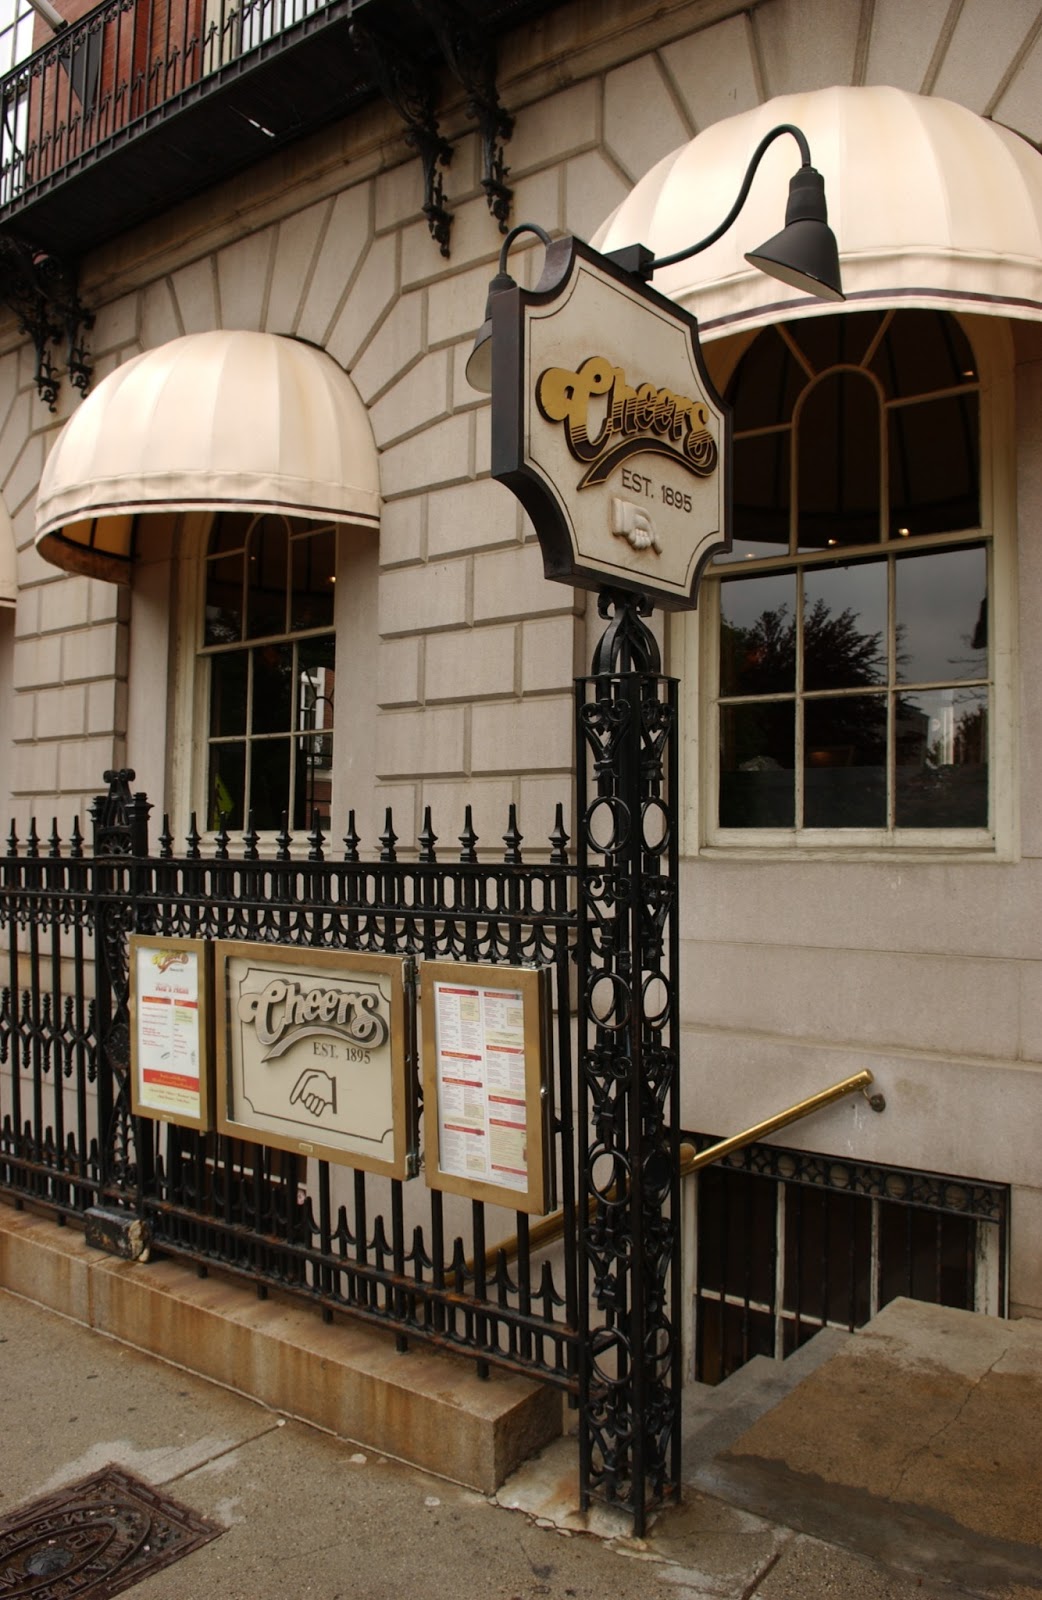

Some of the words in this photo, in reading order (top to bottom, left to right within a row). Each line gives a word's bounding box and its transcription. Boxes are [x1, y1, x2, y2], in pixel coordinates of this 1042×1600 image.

[535, 356, 718, 489] Cheers
[621, 468, 655, 499] EST.
[661, 485, 692, 513] 1895
[237, 979, 389, 1063] Cheers
[312, 1041, 340, 1060] EST.
[345, 1047, 371, 1064] 1895
